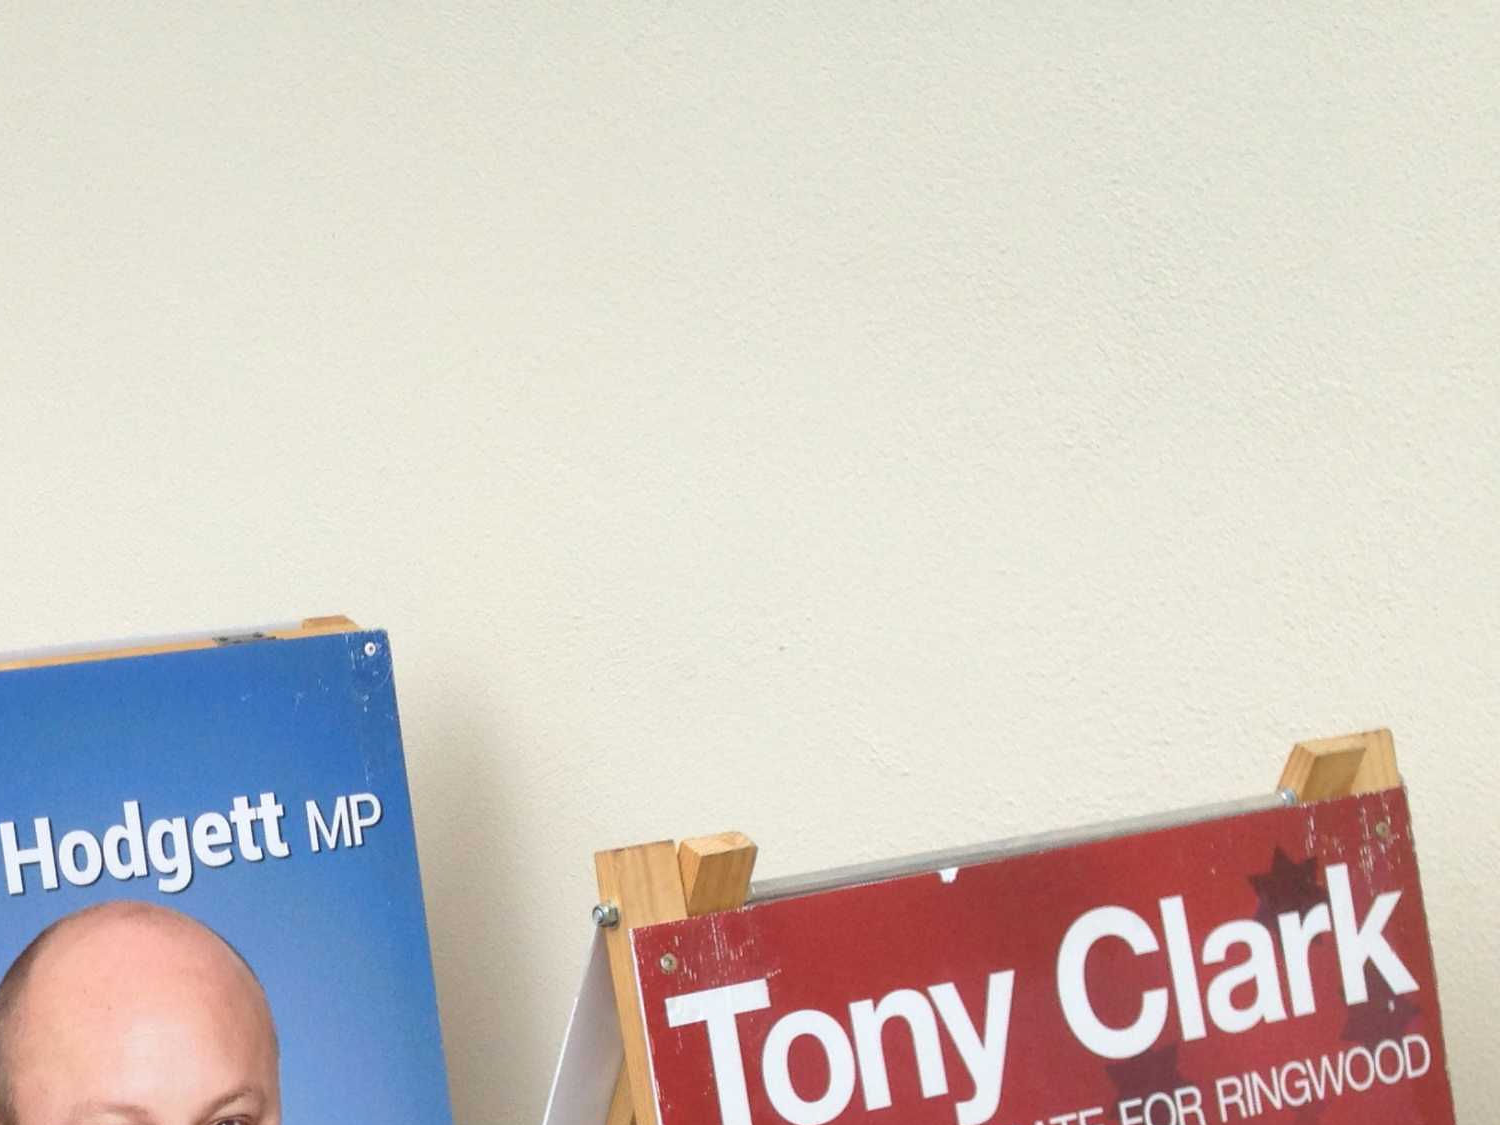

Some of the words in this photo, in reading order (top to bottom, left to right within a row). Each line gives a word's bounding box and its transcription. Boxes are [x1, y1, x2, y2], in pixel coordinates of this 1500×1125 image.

[0, 792, 290, 894] Hodgett
[305, 792, 383, 851] MP
[1056, 863, 1420, 1061] Clark
[1218, 1034, 1431, 1123] RINGWOOD
